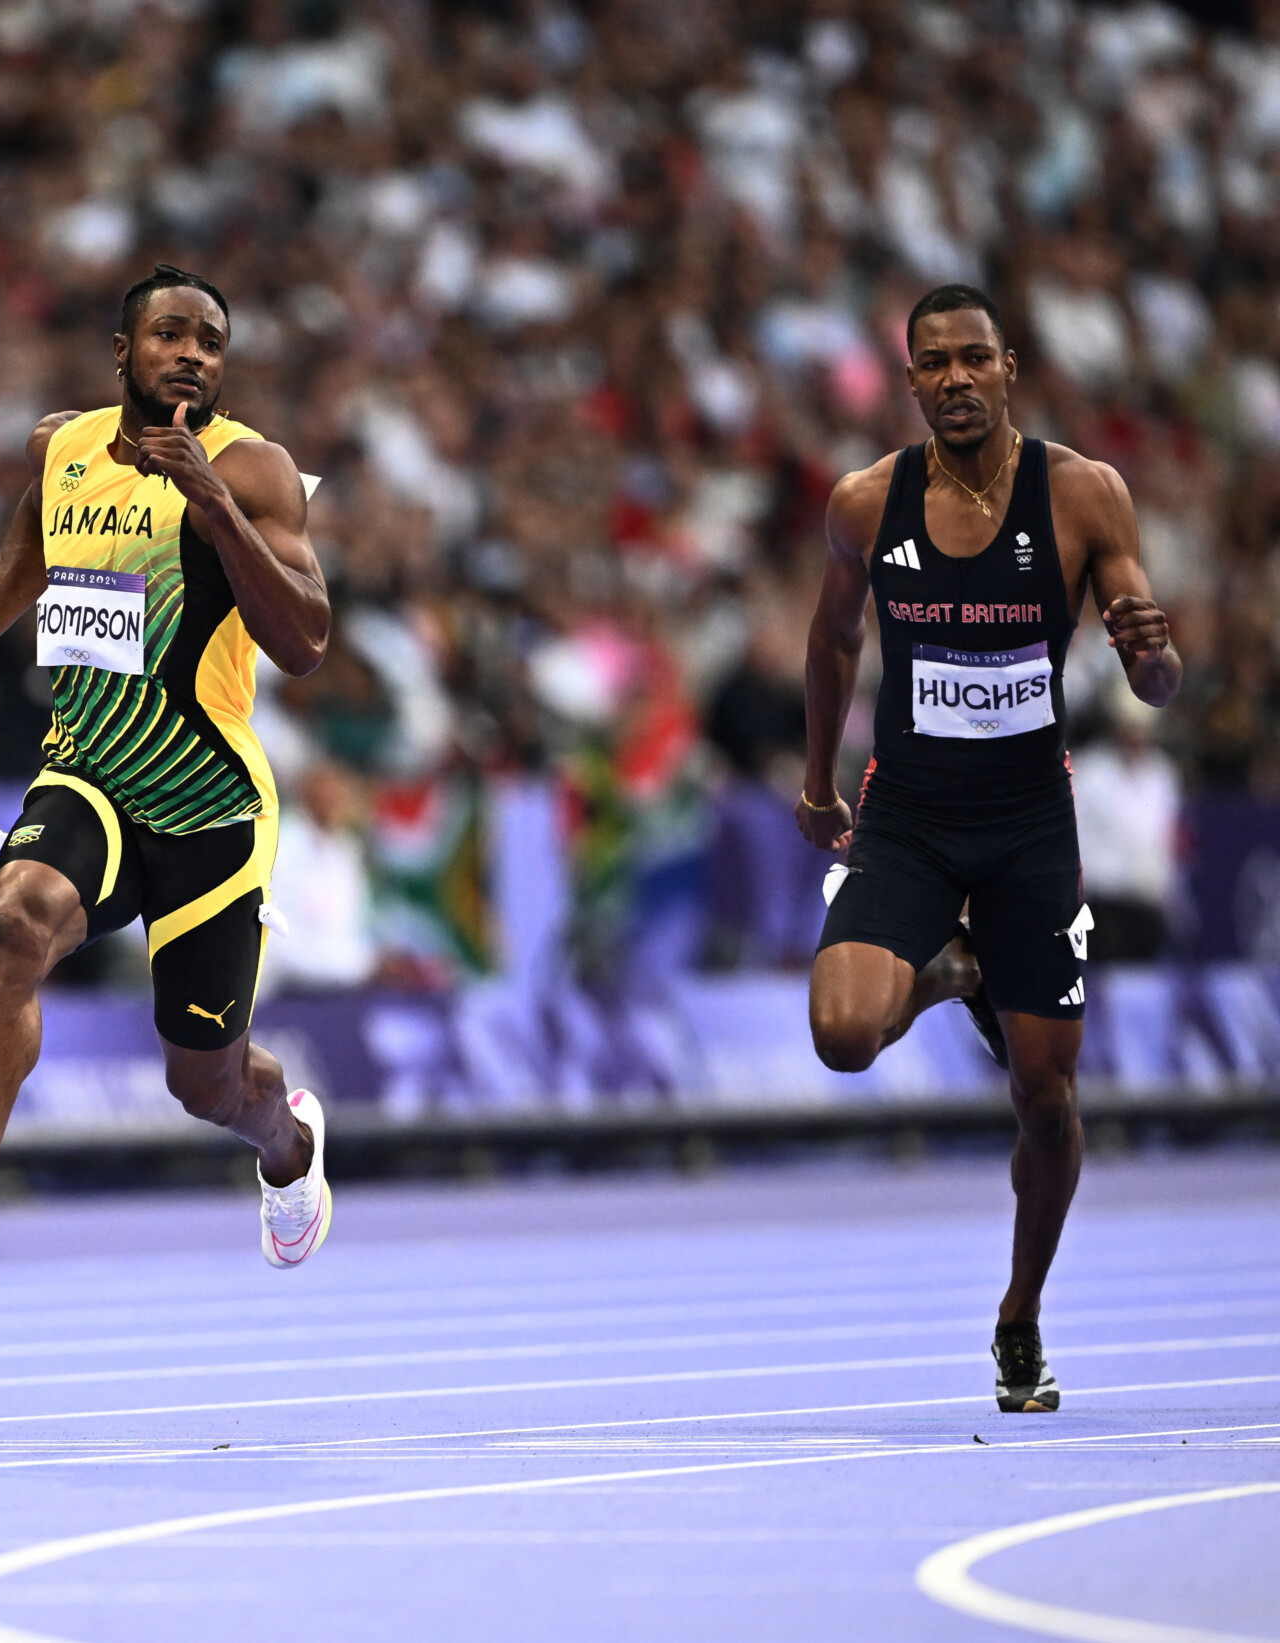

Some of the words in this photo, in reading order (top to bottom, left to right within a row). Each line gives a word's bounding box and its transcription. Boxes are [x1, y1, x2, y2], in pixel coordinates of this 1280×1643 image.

[48, 504, 153, 539] JAMAICA
[53, 571, 86, 583] PARIS
[89, 575, 117, 586] 2024
[37, 603, 141, 642] HOMPSON
[888, 600, 954, 623] GREAT
[961, 603, 1042, 623] BRITAIN
[946, 651, 980, 663] PARIS
[984, 653, 1015, 663] 2024
[919, 674, 1047, 711] HUGHES
